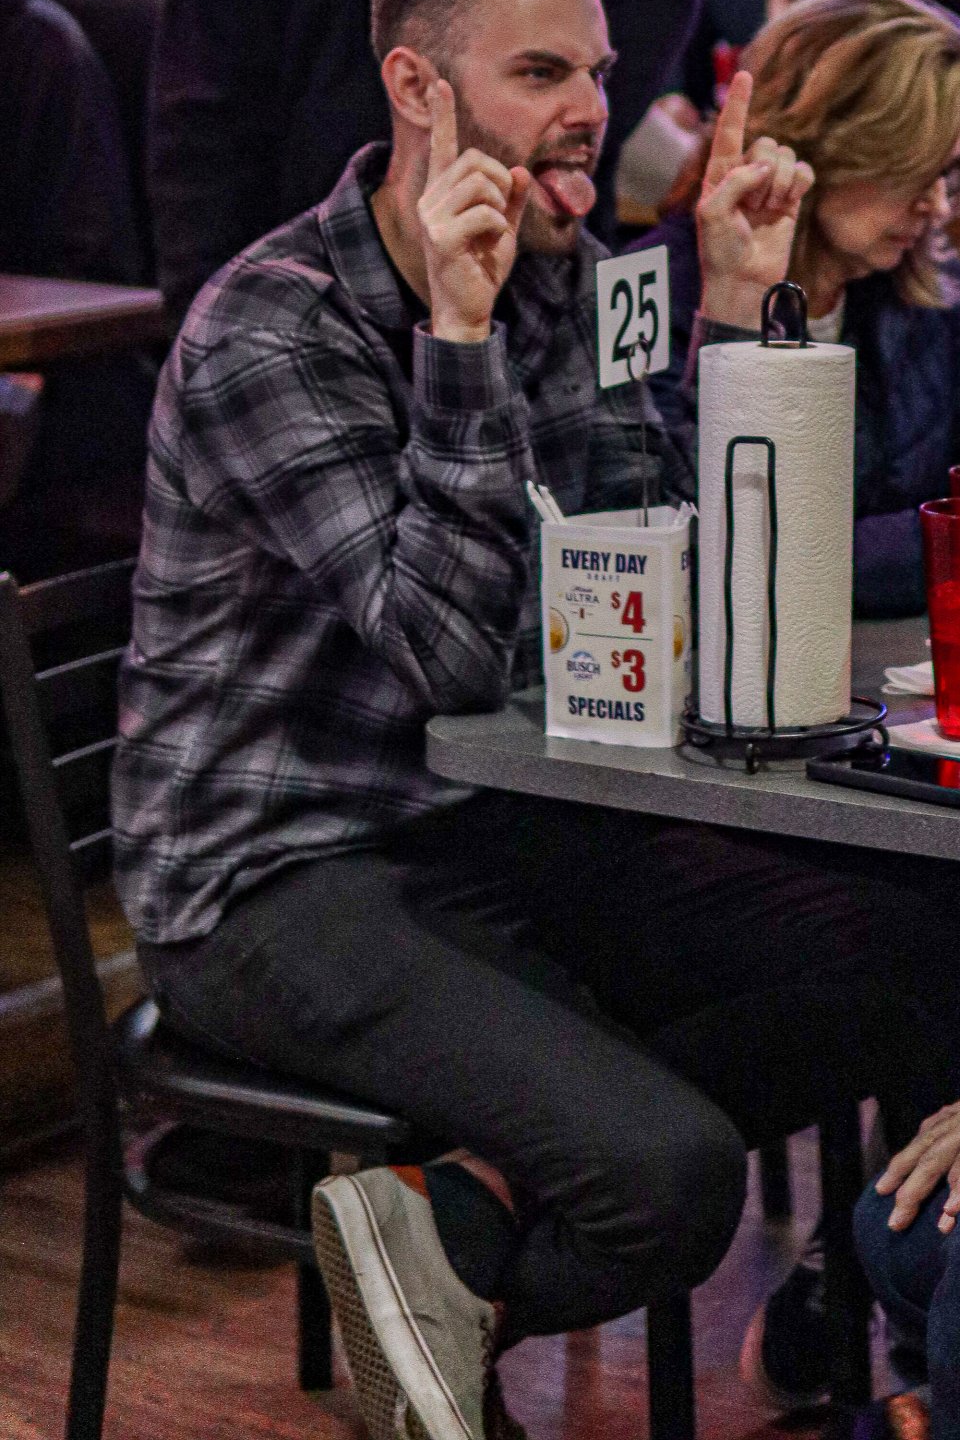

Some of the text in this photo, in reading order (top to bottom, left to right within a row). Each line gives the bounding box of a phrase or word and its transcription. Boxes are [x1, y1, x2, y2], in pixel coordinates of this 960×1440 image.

[610, 270, 658, 362] 25
[562, 548, 647, 575] EVERY DAY
[565, 592, 600, 603] ULTRA
[567, 660, 600, 674] BUSCH
[568, 695, 645, 722] SPECIALS
